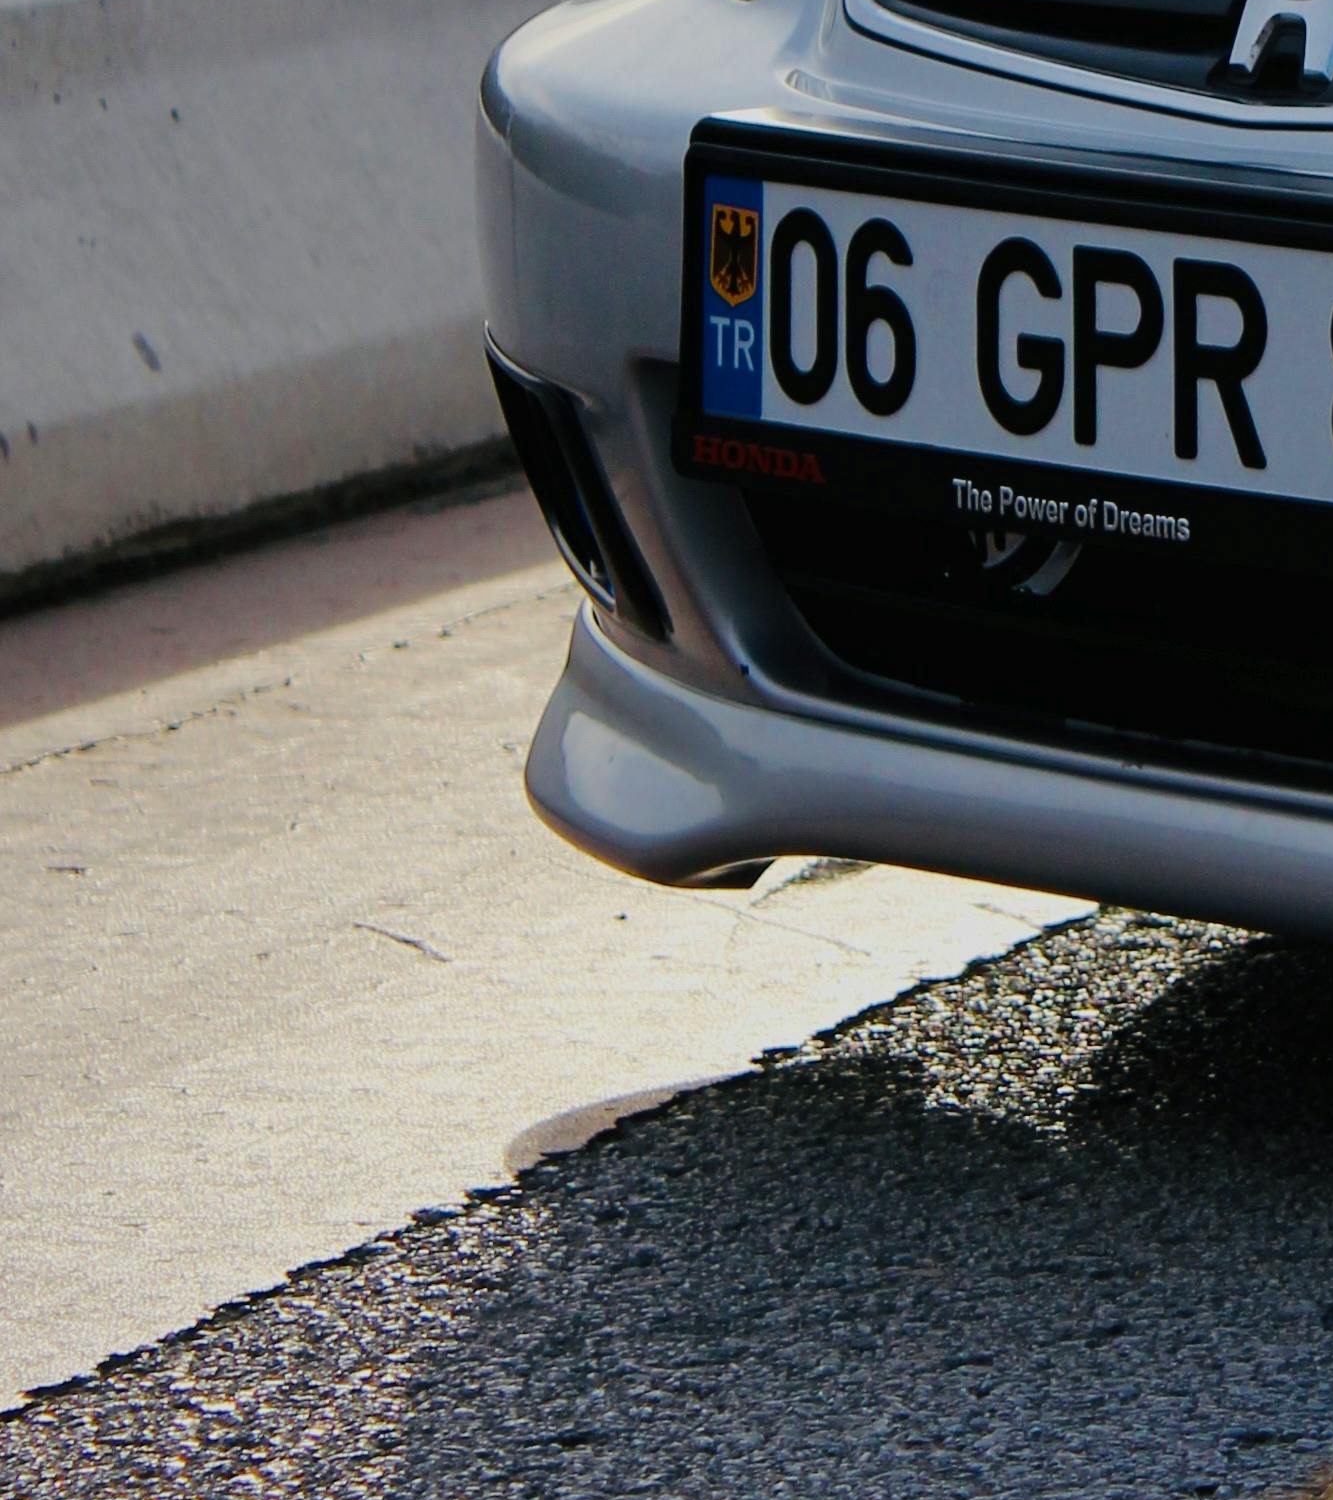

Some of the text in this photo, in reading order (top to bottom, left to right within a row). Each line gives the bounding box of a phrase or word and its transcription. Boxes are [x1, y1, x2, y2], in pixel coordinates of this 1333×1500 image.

[709, 314, 756, 373] TR
[770, 205, 917, 417] 06
[976, 236, 1268, 471] GPR
[692, 434, 826, 485] HONDA
[952, 477, 1191, 543] The Power of Dreams
